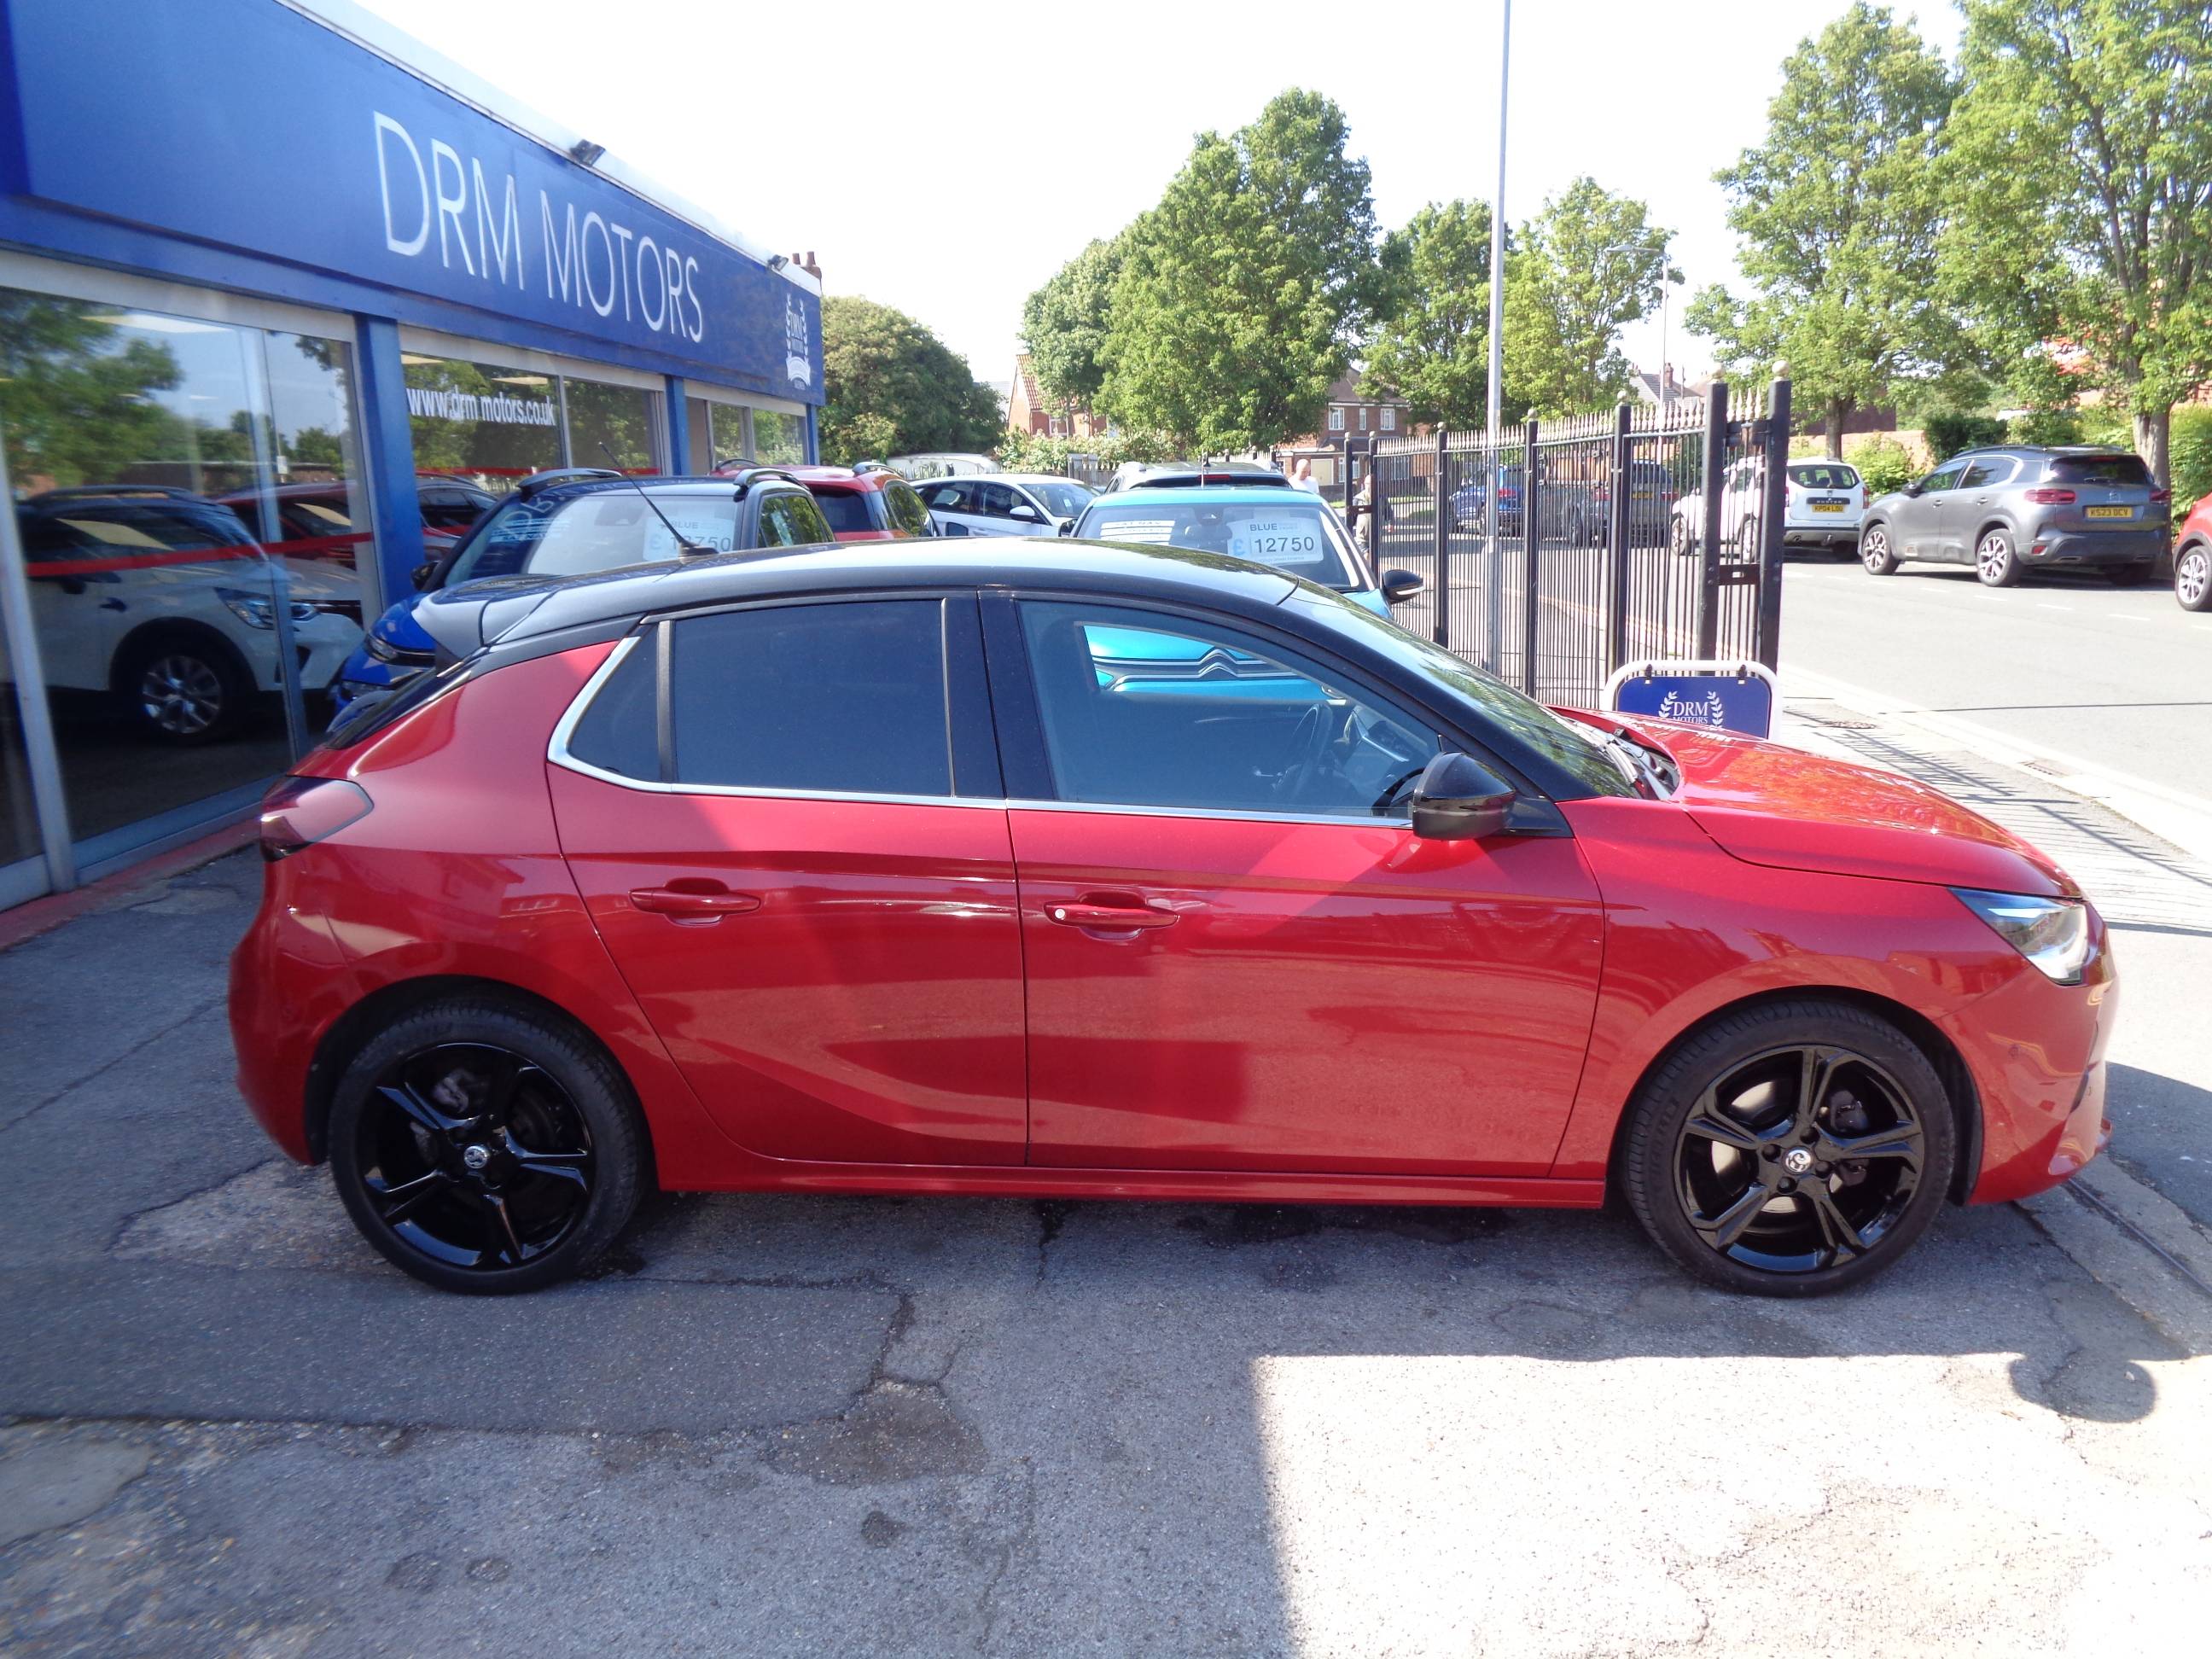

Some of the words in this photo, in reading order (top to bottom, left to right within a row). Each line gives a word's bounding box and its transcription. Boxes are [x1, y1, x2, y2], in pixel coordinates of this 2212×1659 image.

[374, 110, 525, 291] DRM
[540, 189, 703, 343] MOTORS
[480, 392, 556, 426] motors.co.uk
[1249, 523, 1278, 532] BLUE
[1232, 538, 1245, 556] £
[1254, 537, 1314, 553] 12750
[1673, 701, 1708, 716] DRM
